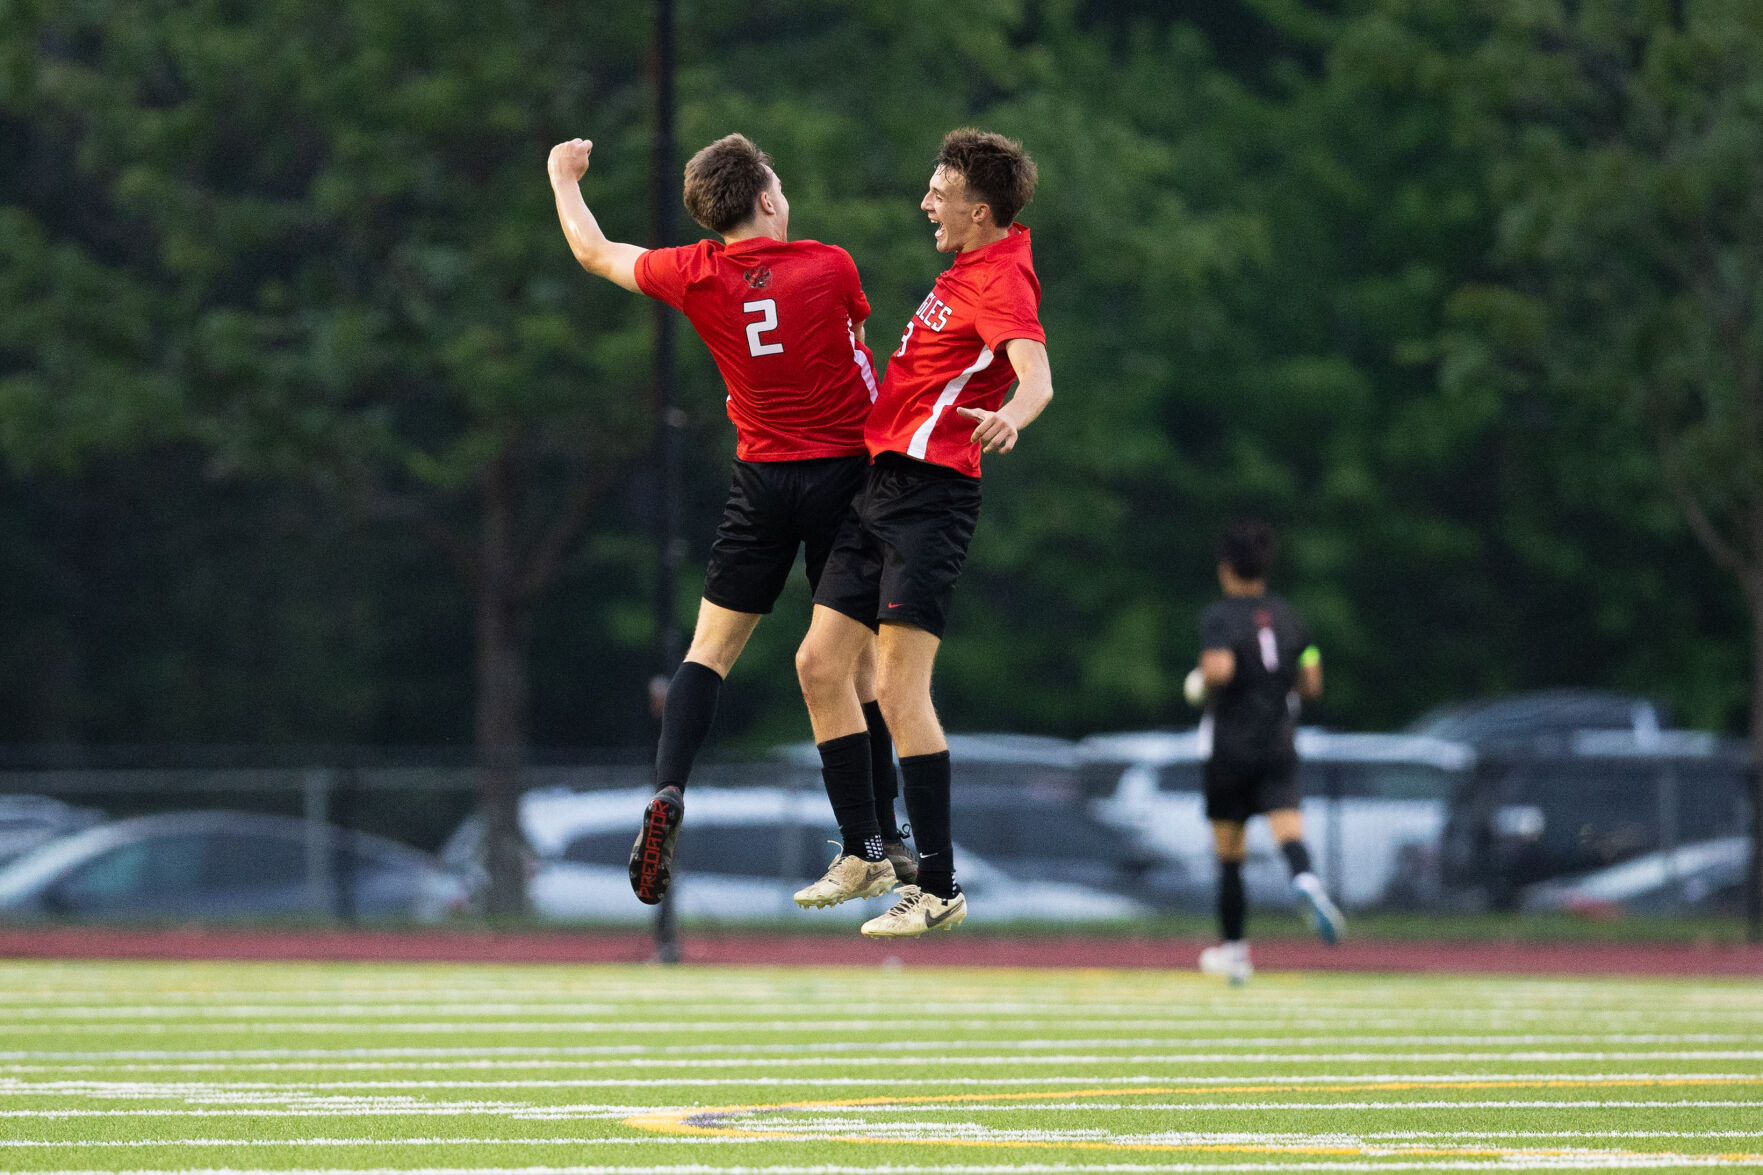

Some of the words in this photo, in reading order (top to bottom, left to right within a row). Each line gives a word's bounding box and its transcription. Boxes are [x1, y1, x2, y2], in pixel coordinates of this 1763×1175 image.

[743, 298, 785, 357] 2
[915, 291, 953, 333] GLES
[1258, 627, 1279, 671] 1
[640, 800, 670, 898] PREDATOR
